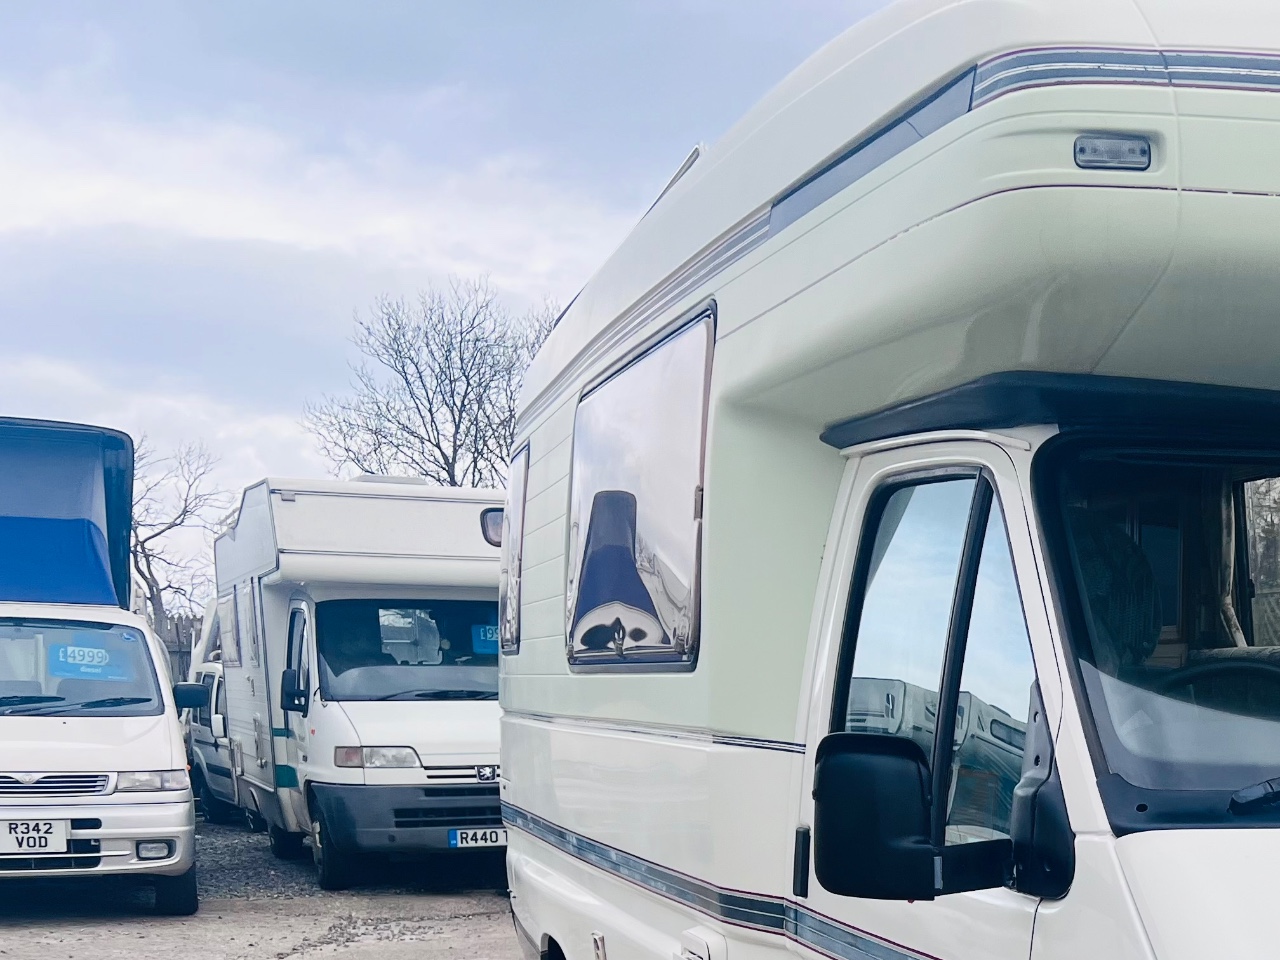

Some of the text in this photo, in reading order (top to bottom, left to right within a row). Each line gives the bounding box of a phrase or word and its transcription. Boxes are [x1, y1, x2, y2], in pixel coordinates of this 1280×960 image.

[8, 822, 53, 835] R342
[15, 836, 48, 848] VOD
[460, 830, 499, 845] R440
